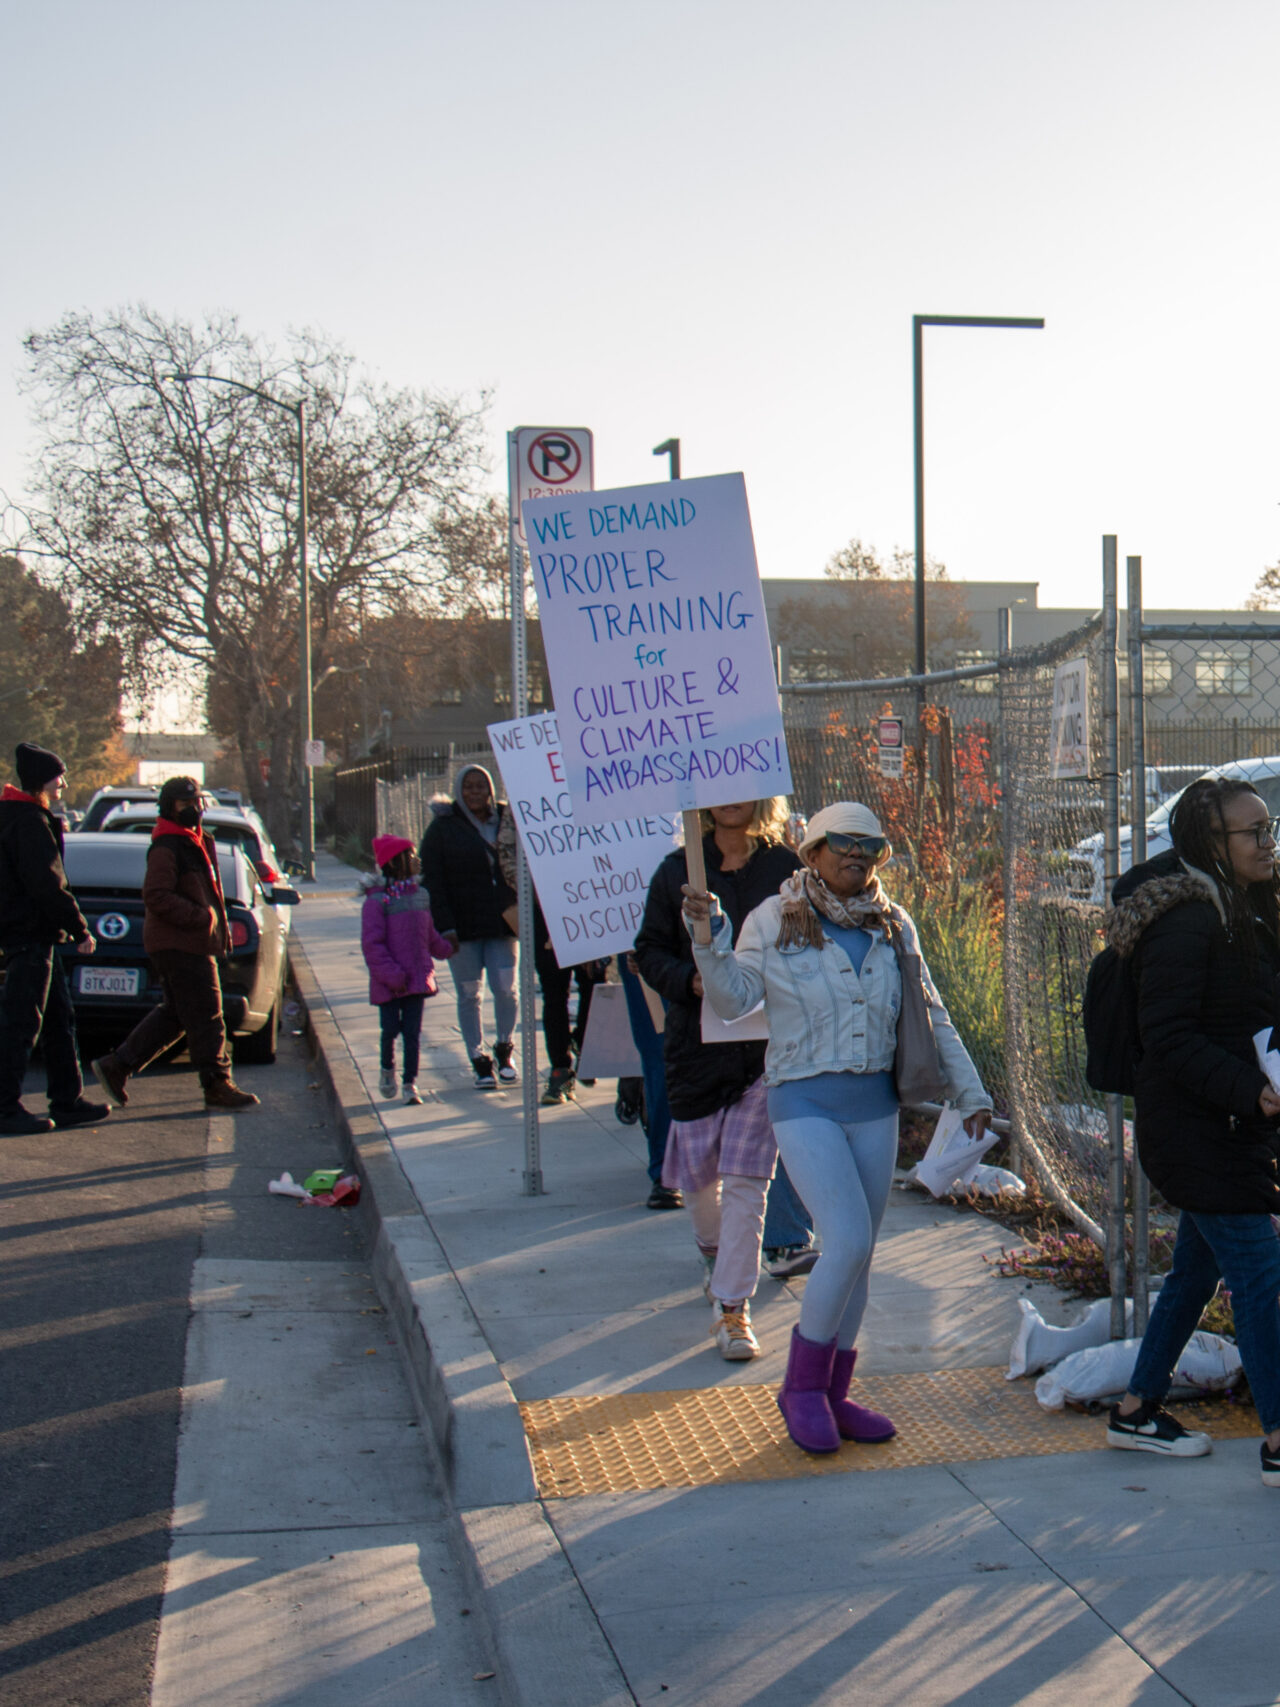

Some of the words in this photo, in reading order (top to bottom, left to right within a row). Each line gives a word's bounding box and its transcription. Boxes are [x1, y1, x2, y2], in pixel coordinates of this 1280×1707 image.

[533, 510, 576, 544] WE
[588, 498, 696, 537] DEMAND
[538, 549, 679, 599] PROPER
[578, 591, 754, 643] TRAINING
[634, 643, 667, 669] for
[573, 671, 705, 723] CULTURE
[717, 657, 739, 695] &
[493, 726, 526, 752] WE
[580, 711, 718, 758] CLIMATE
[586, 737, 782, 802] AMBASSADORS!
[517, 792, 574, 825] RAC
[593, 853, 613, 873] IN
[563, 868, 650, 904] SCHOOL
[562, 901, 647, 942] DISCIP
[84, 977, 135, 991] 8TKJ017
